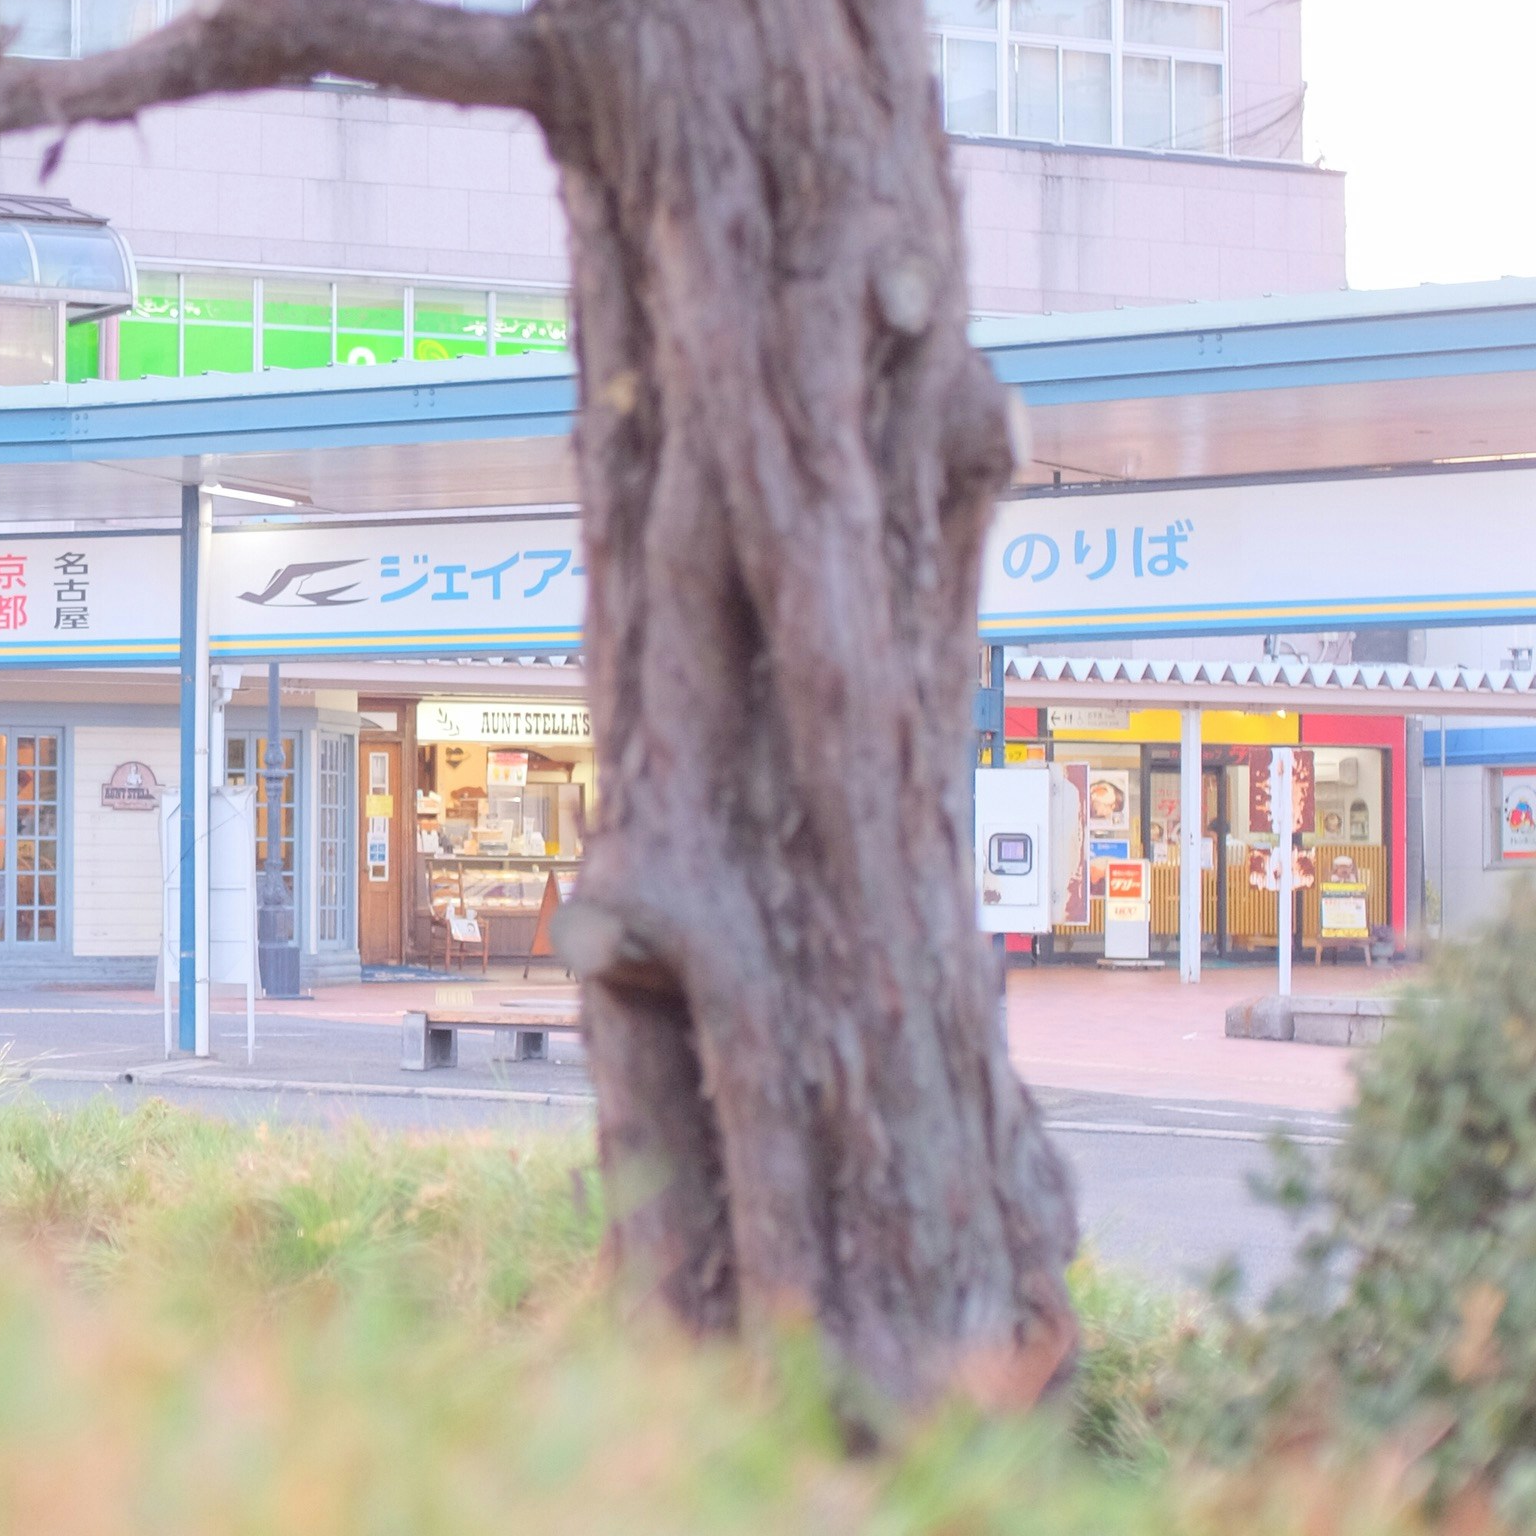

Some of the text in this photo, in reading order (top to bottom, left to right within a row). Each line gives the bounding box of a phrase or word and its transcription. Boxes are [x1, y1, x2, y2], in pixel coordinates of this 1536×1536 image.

[1002, 518, 1194, 583] のりば
[54, 552, 90, 629] 名古屋
[481, 711, 590, 735] AUNT STELLA'S
